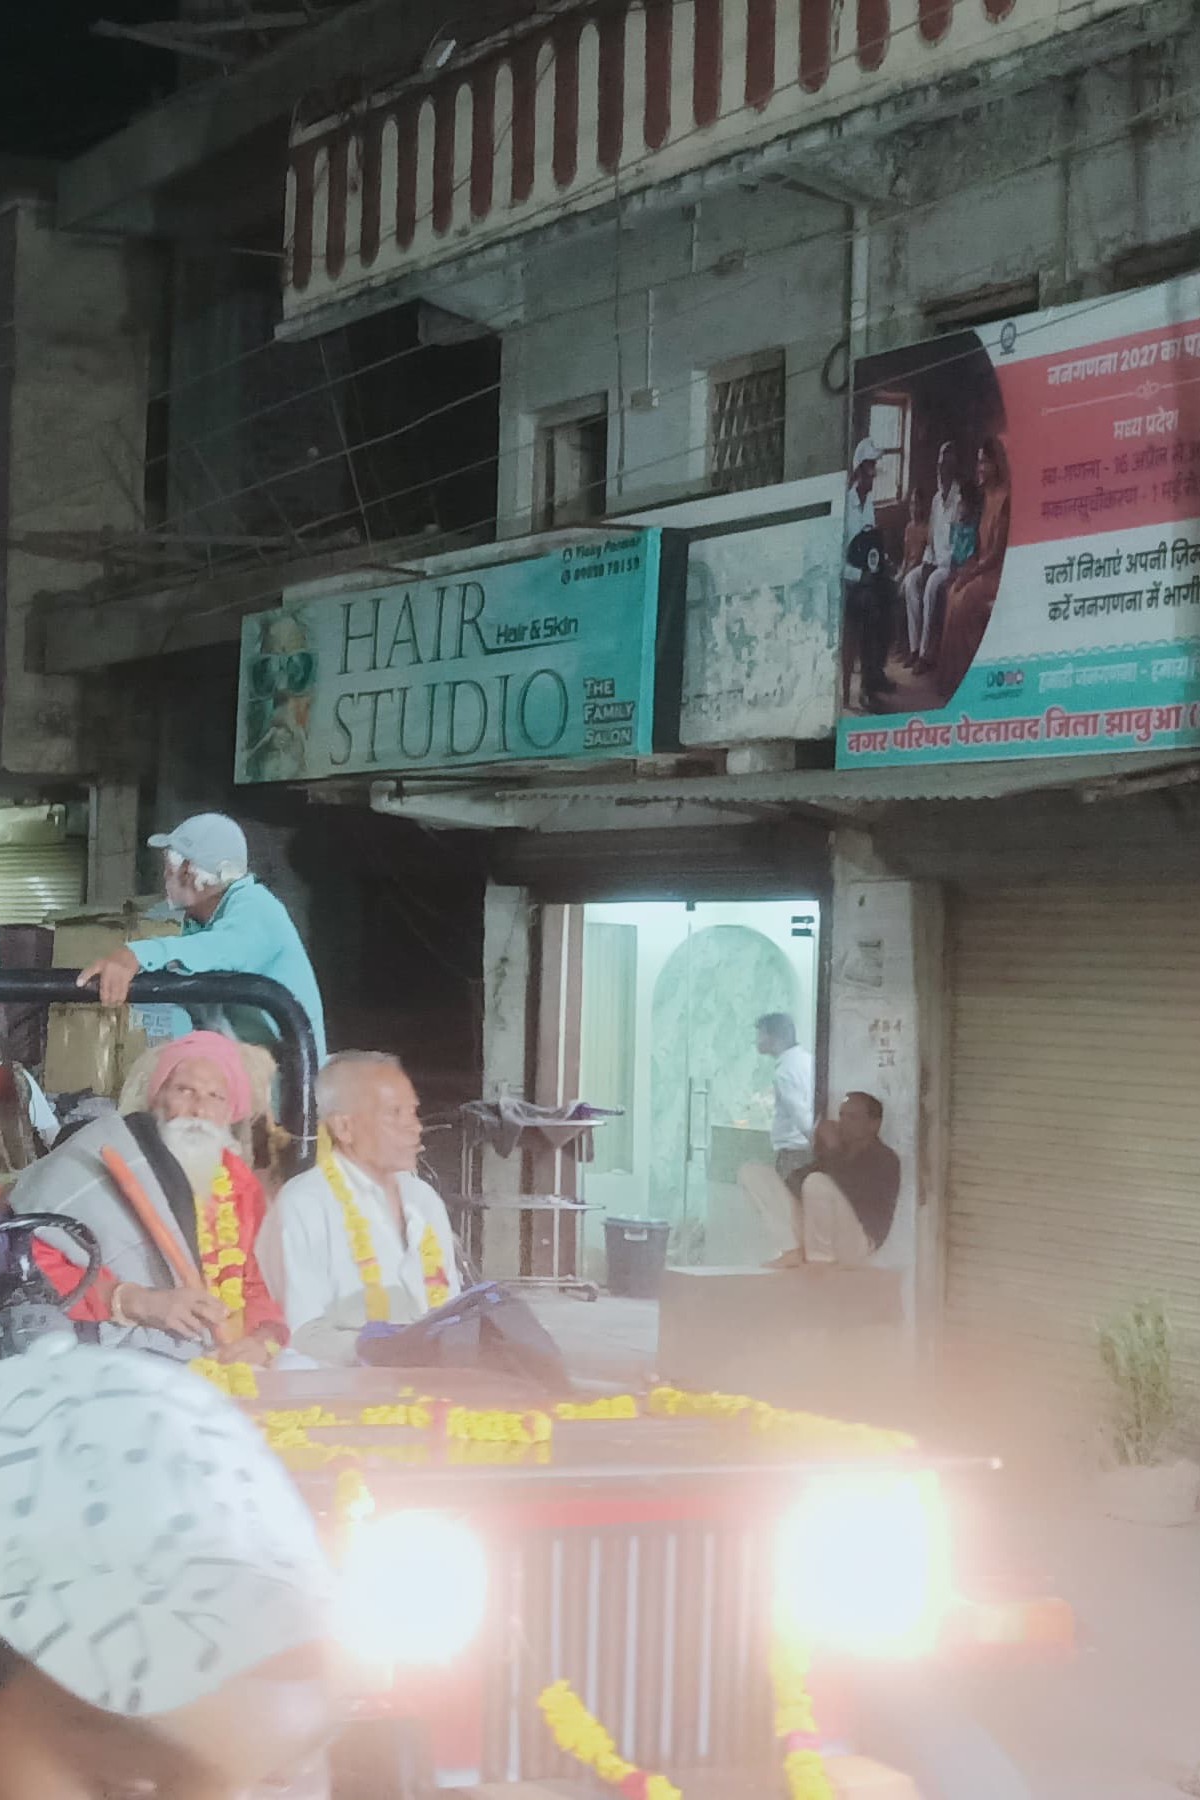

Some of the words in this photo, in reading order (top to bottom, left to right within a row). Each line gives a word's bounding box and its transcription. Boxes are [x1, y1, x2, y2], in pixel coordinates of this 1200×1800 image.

[1047, 351, 1118, 384] जनगणना
[1120, 343, 1159, 371] 2027
[1126, 541, 1167, 574] अपनी
[1073, 590, 1143, 618] जनगणना
[1146, 580, 1163, 609] में
[1163, 575, 1200, 608] भागी
[337, 580, 492, 675] HAIR
[496, 623, 528, 644] Hair
[543, 616, 578, 638] Skin
[584, 678, 614, 698] THE
[329, 667, 570, 766] STUDIO
[584, 701, 635, 725] FAMILY
[847, 731, 888, 753] नगर
[892, 718, 952, 750] परिषद
[957, 715, 1041, 745] पेटलावद
[1045, 706, 1099, 739] जिला
[1104, 704, 1183, 743] झाबुआ
[584, 728, 632, 749] SALON
